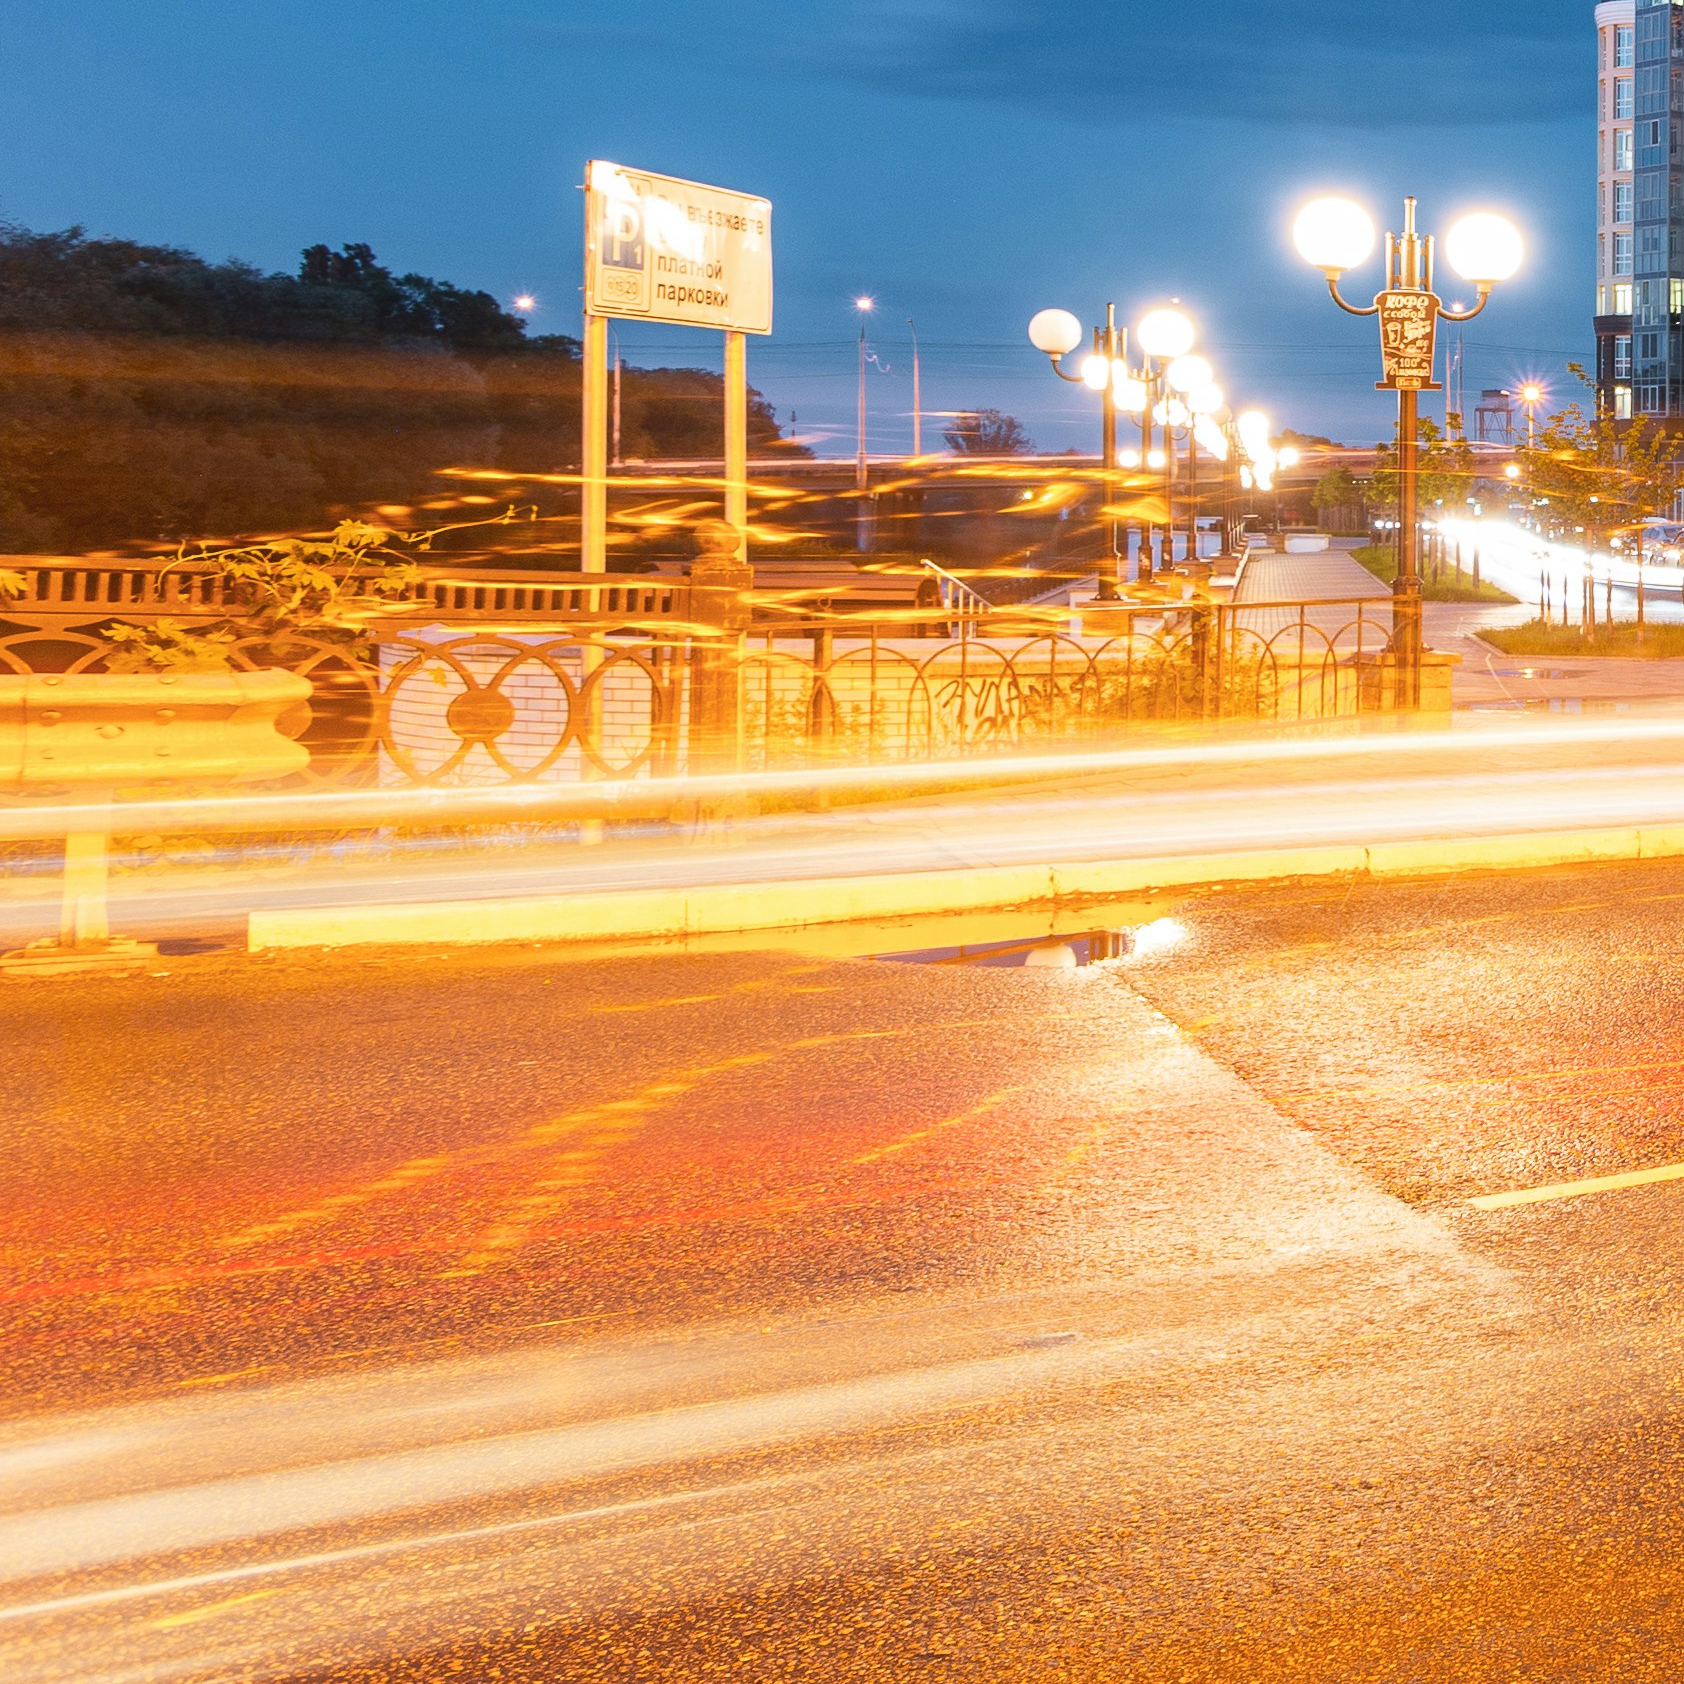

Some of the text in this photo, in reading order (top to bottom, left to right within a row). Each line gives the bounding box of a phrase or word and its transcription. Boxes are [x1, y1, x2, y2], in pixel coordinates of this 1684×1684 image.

[687, 205, 764, 235] въезжаете
[657, 255, 723, 281] платной
[656, 283, 729, 308] парковки
